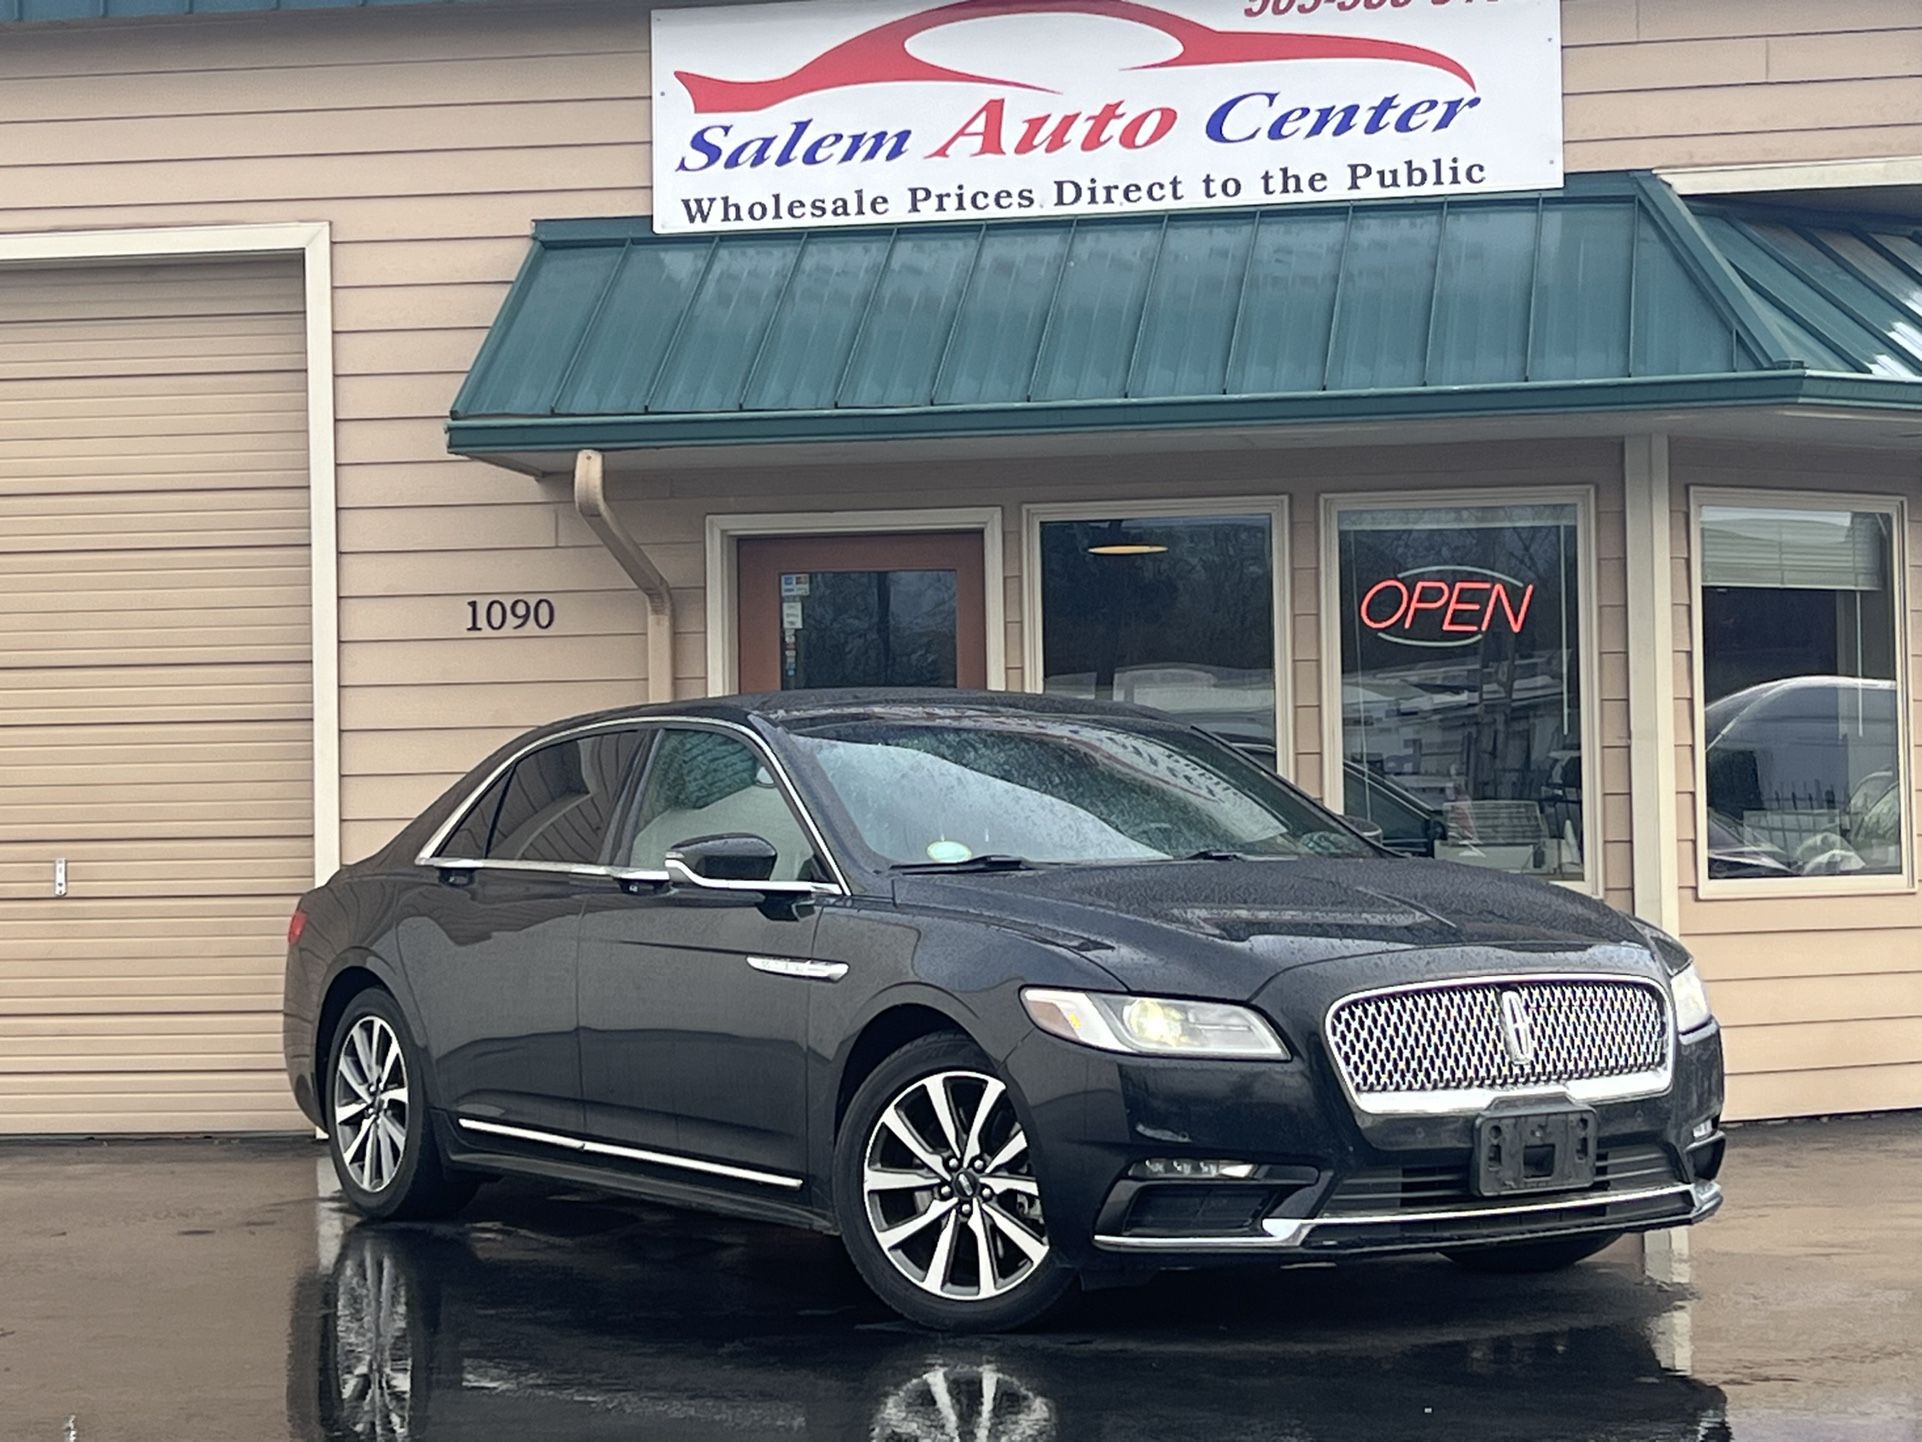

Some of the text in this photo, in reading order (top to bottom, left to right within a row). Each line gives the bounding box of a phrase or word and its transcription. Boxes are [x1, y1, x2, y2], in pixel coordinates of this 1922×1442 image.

[676, 91, 1481, 172] Salem Auto Center
[681, 157, 1487, 224] Wholesale Prices Direct to the Public
[466, 598, 555, 631] 1090
[1360, 579, 1534, 633] OPEN
